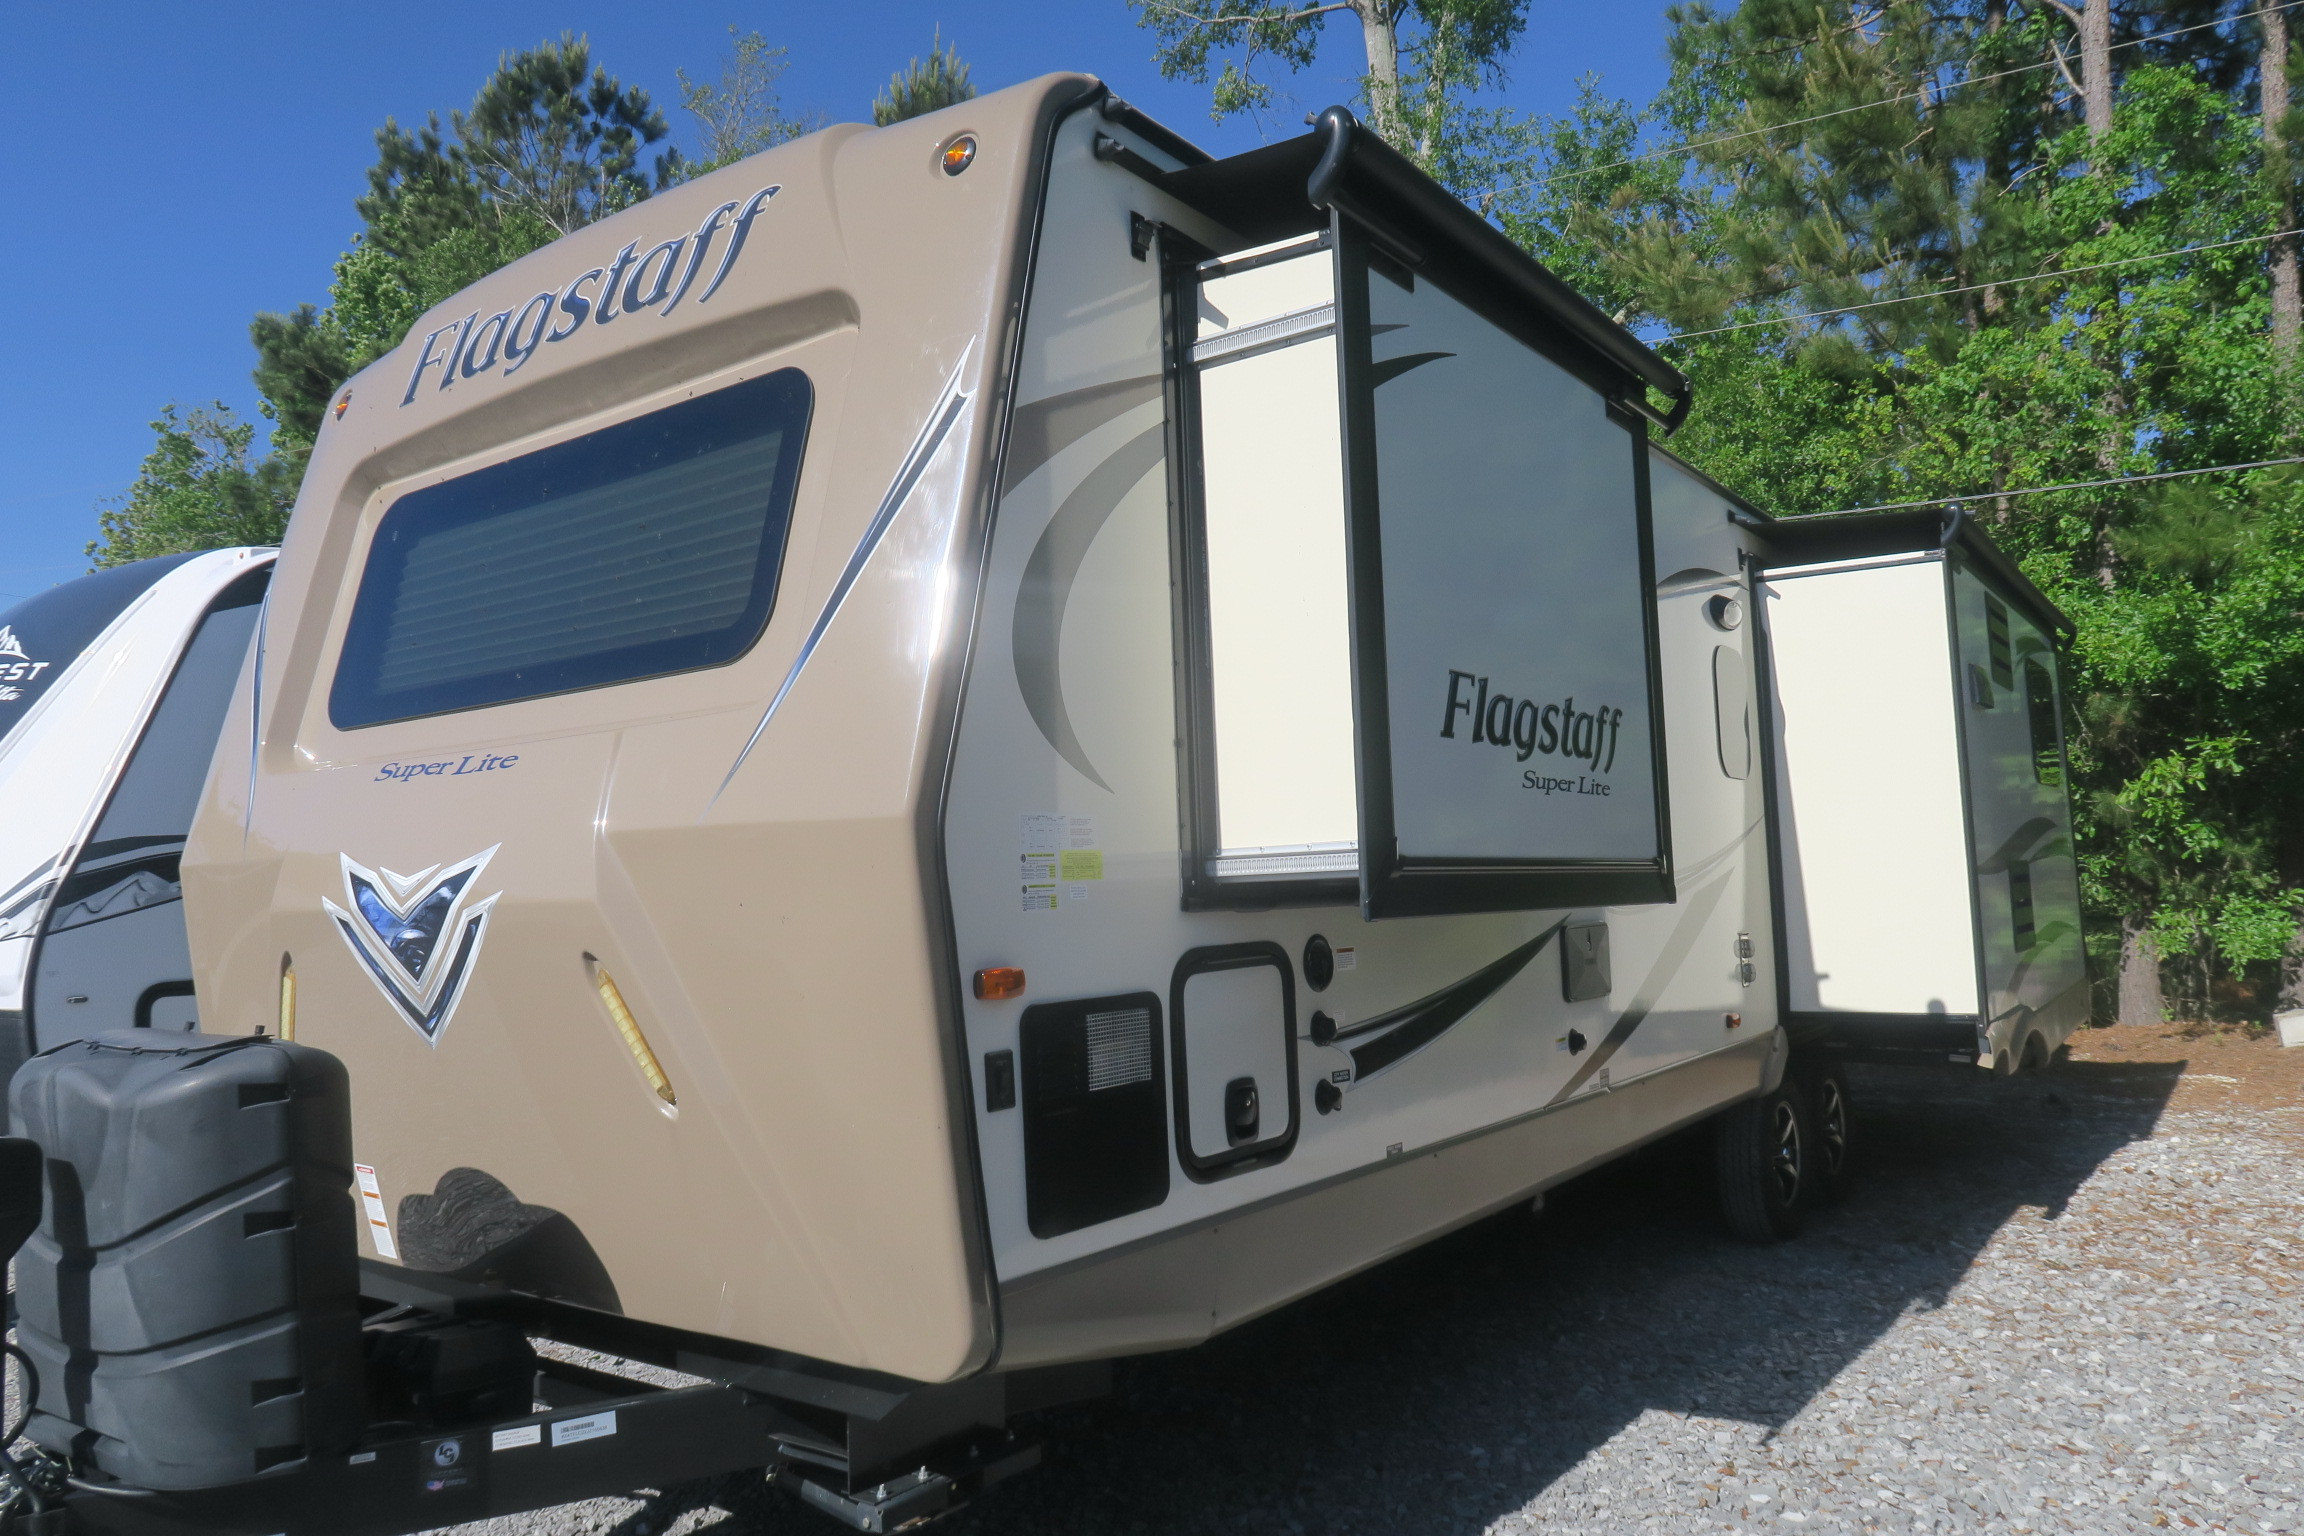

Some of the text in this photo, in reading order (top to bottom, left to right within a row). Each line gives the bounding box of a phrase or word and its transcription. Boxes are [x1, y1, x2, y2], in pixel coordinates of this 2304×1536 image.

[399, 184, 783, 408] Flagstaff
[1440, 668, 1623, 774] Flagstaff
[374, 753, 519, 783] Super Lite
[1522, 770, 1611, 797] Super Lite
